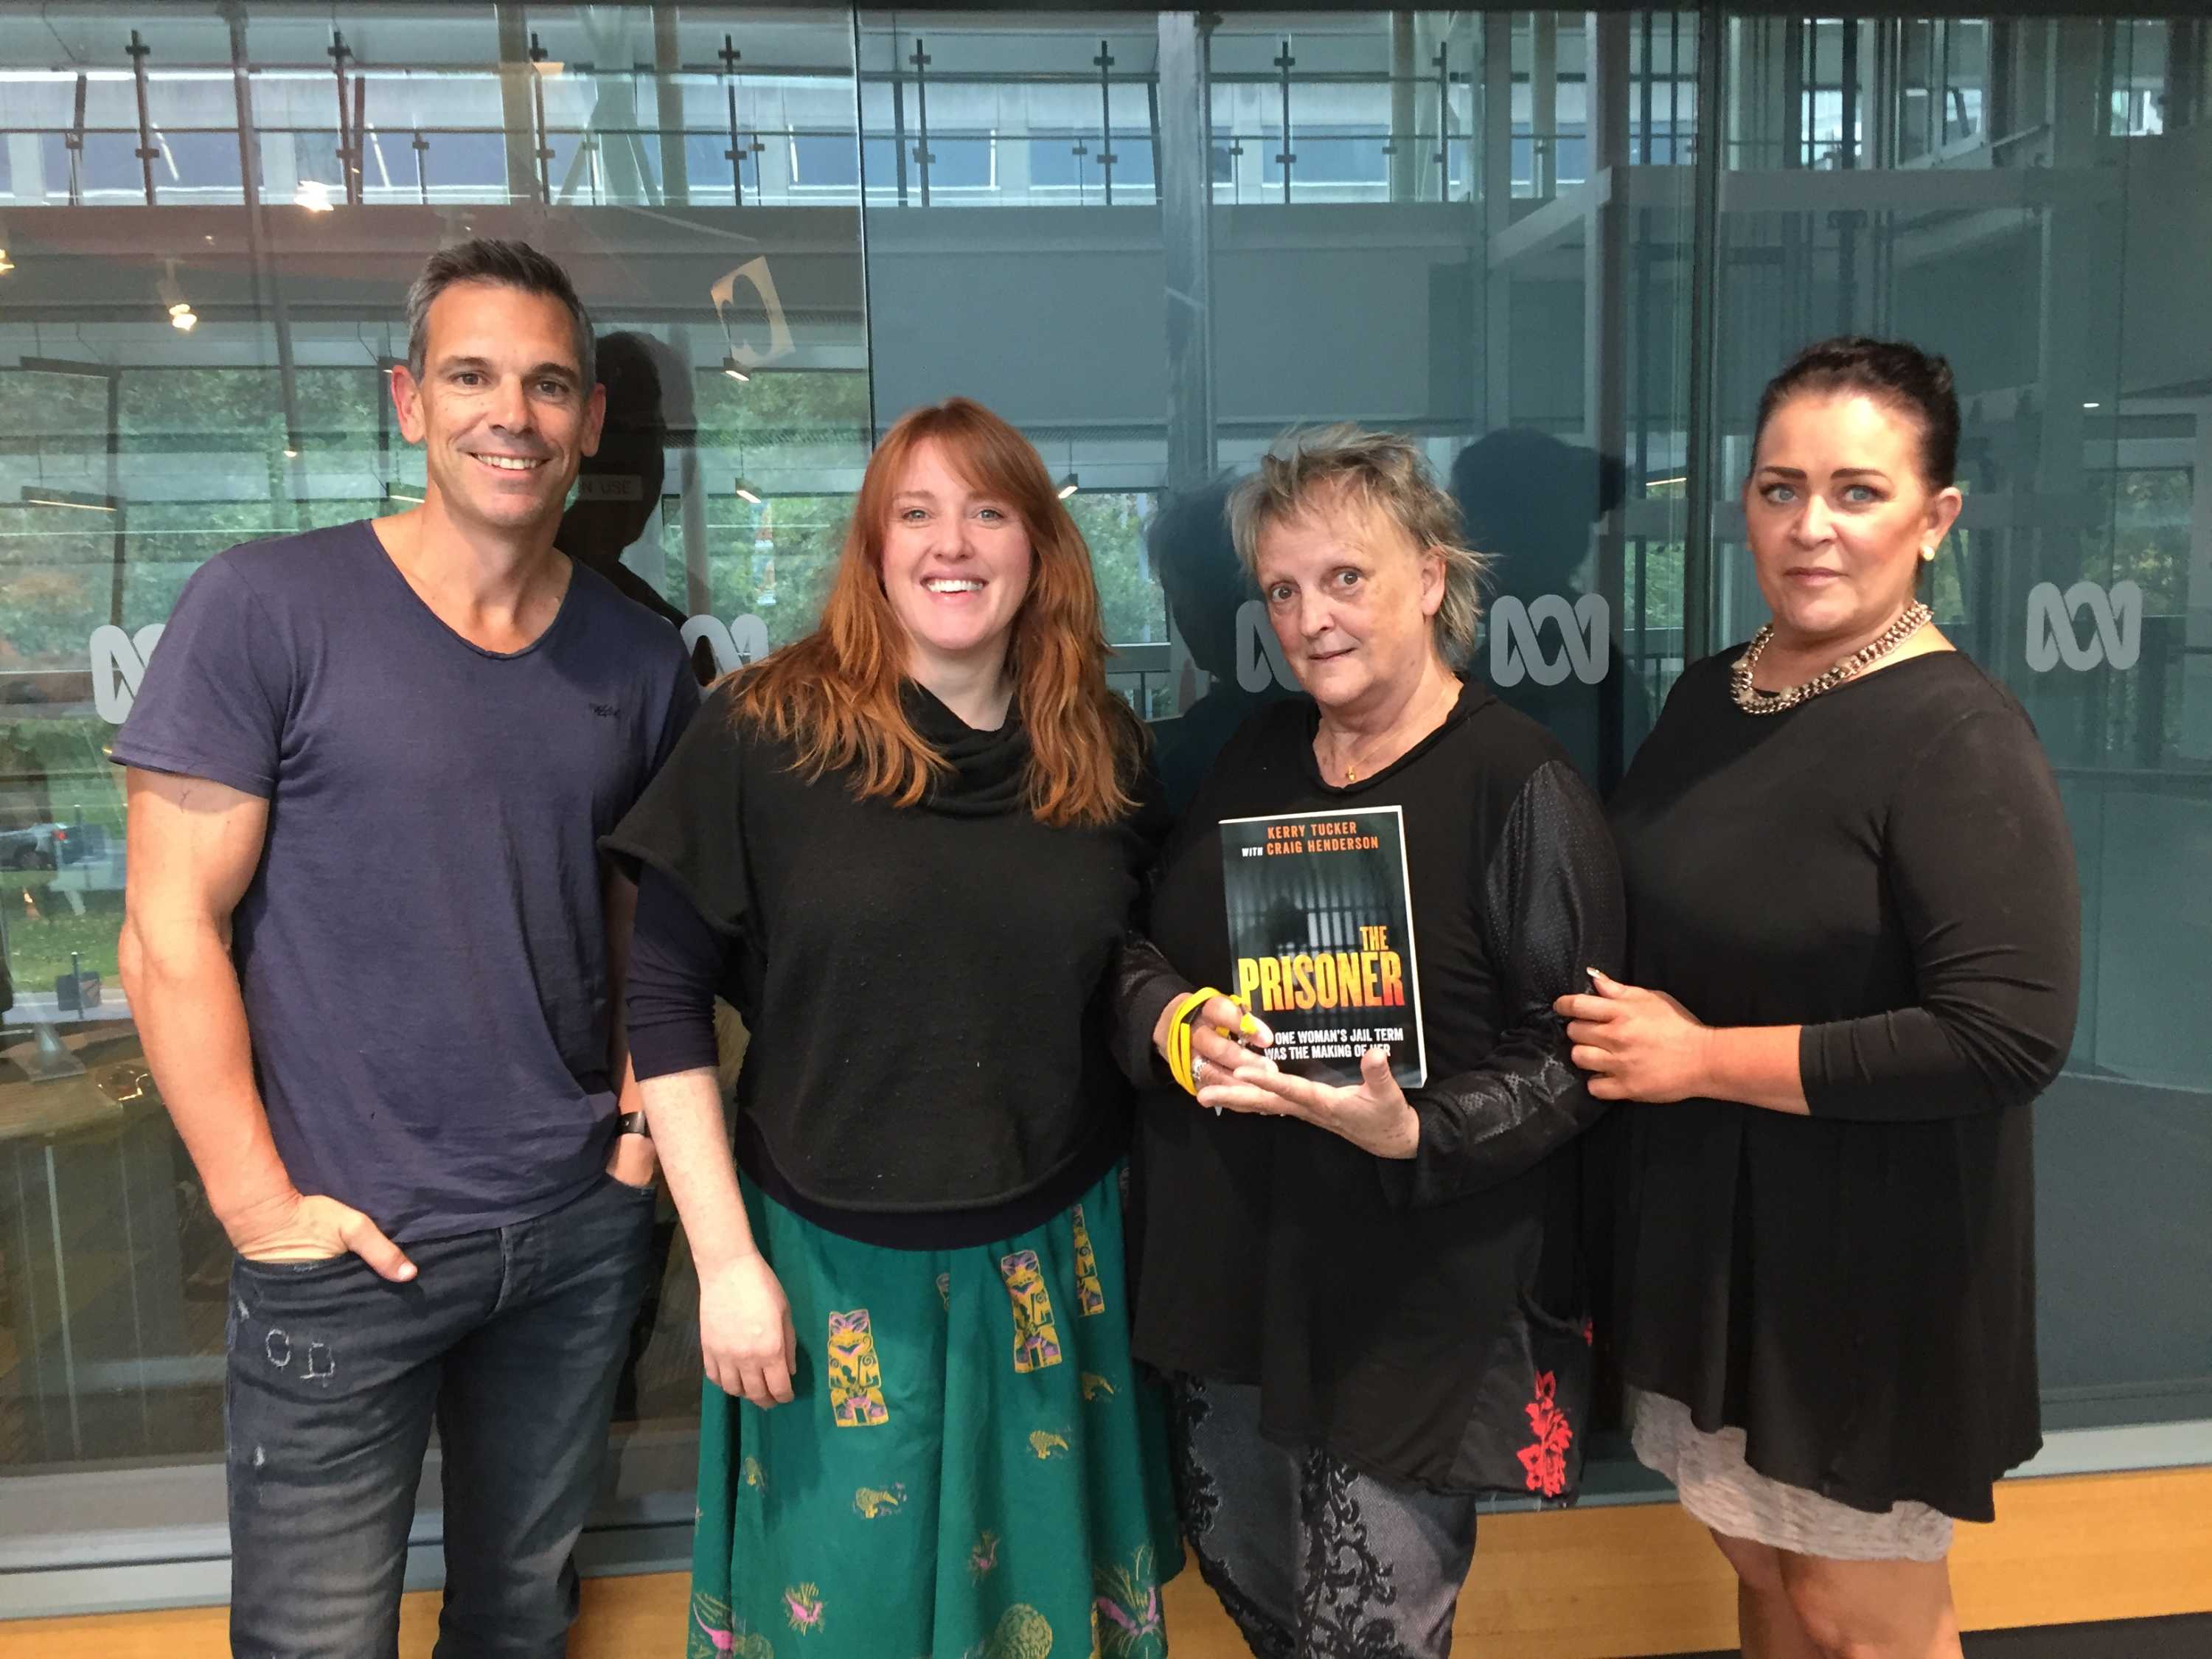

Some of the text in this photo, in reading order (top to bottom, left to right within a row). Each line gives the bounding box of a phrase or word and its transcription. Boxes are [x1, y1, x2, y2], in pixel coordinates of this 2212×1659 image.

[1267, 821, 1357, 840] KERRY TUCKER
[1242, 836, 1379, 857] WITH CRAIG HENDERSON
[1360, 926, 1389, 951] THE
[1238, 951, 1405, 1012] PRISONER
[1275, 1027, 1404, 1046] ONE WOMAN'S JAIL TERM
[1264, 1046, 1287, 1060] WAS
[1289, 1046, 1310, 1060] THE
[1311, 1043, 1352, 1059] MAKING
[1354, 1043, 1367, 1057] OF
